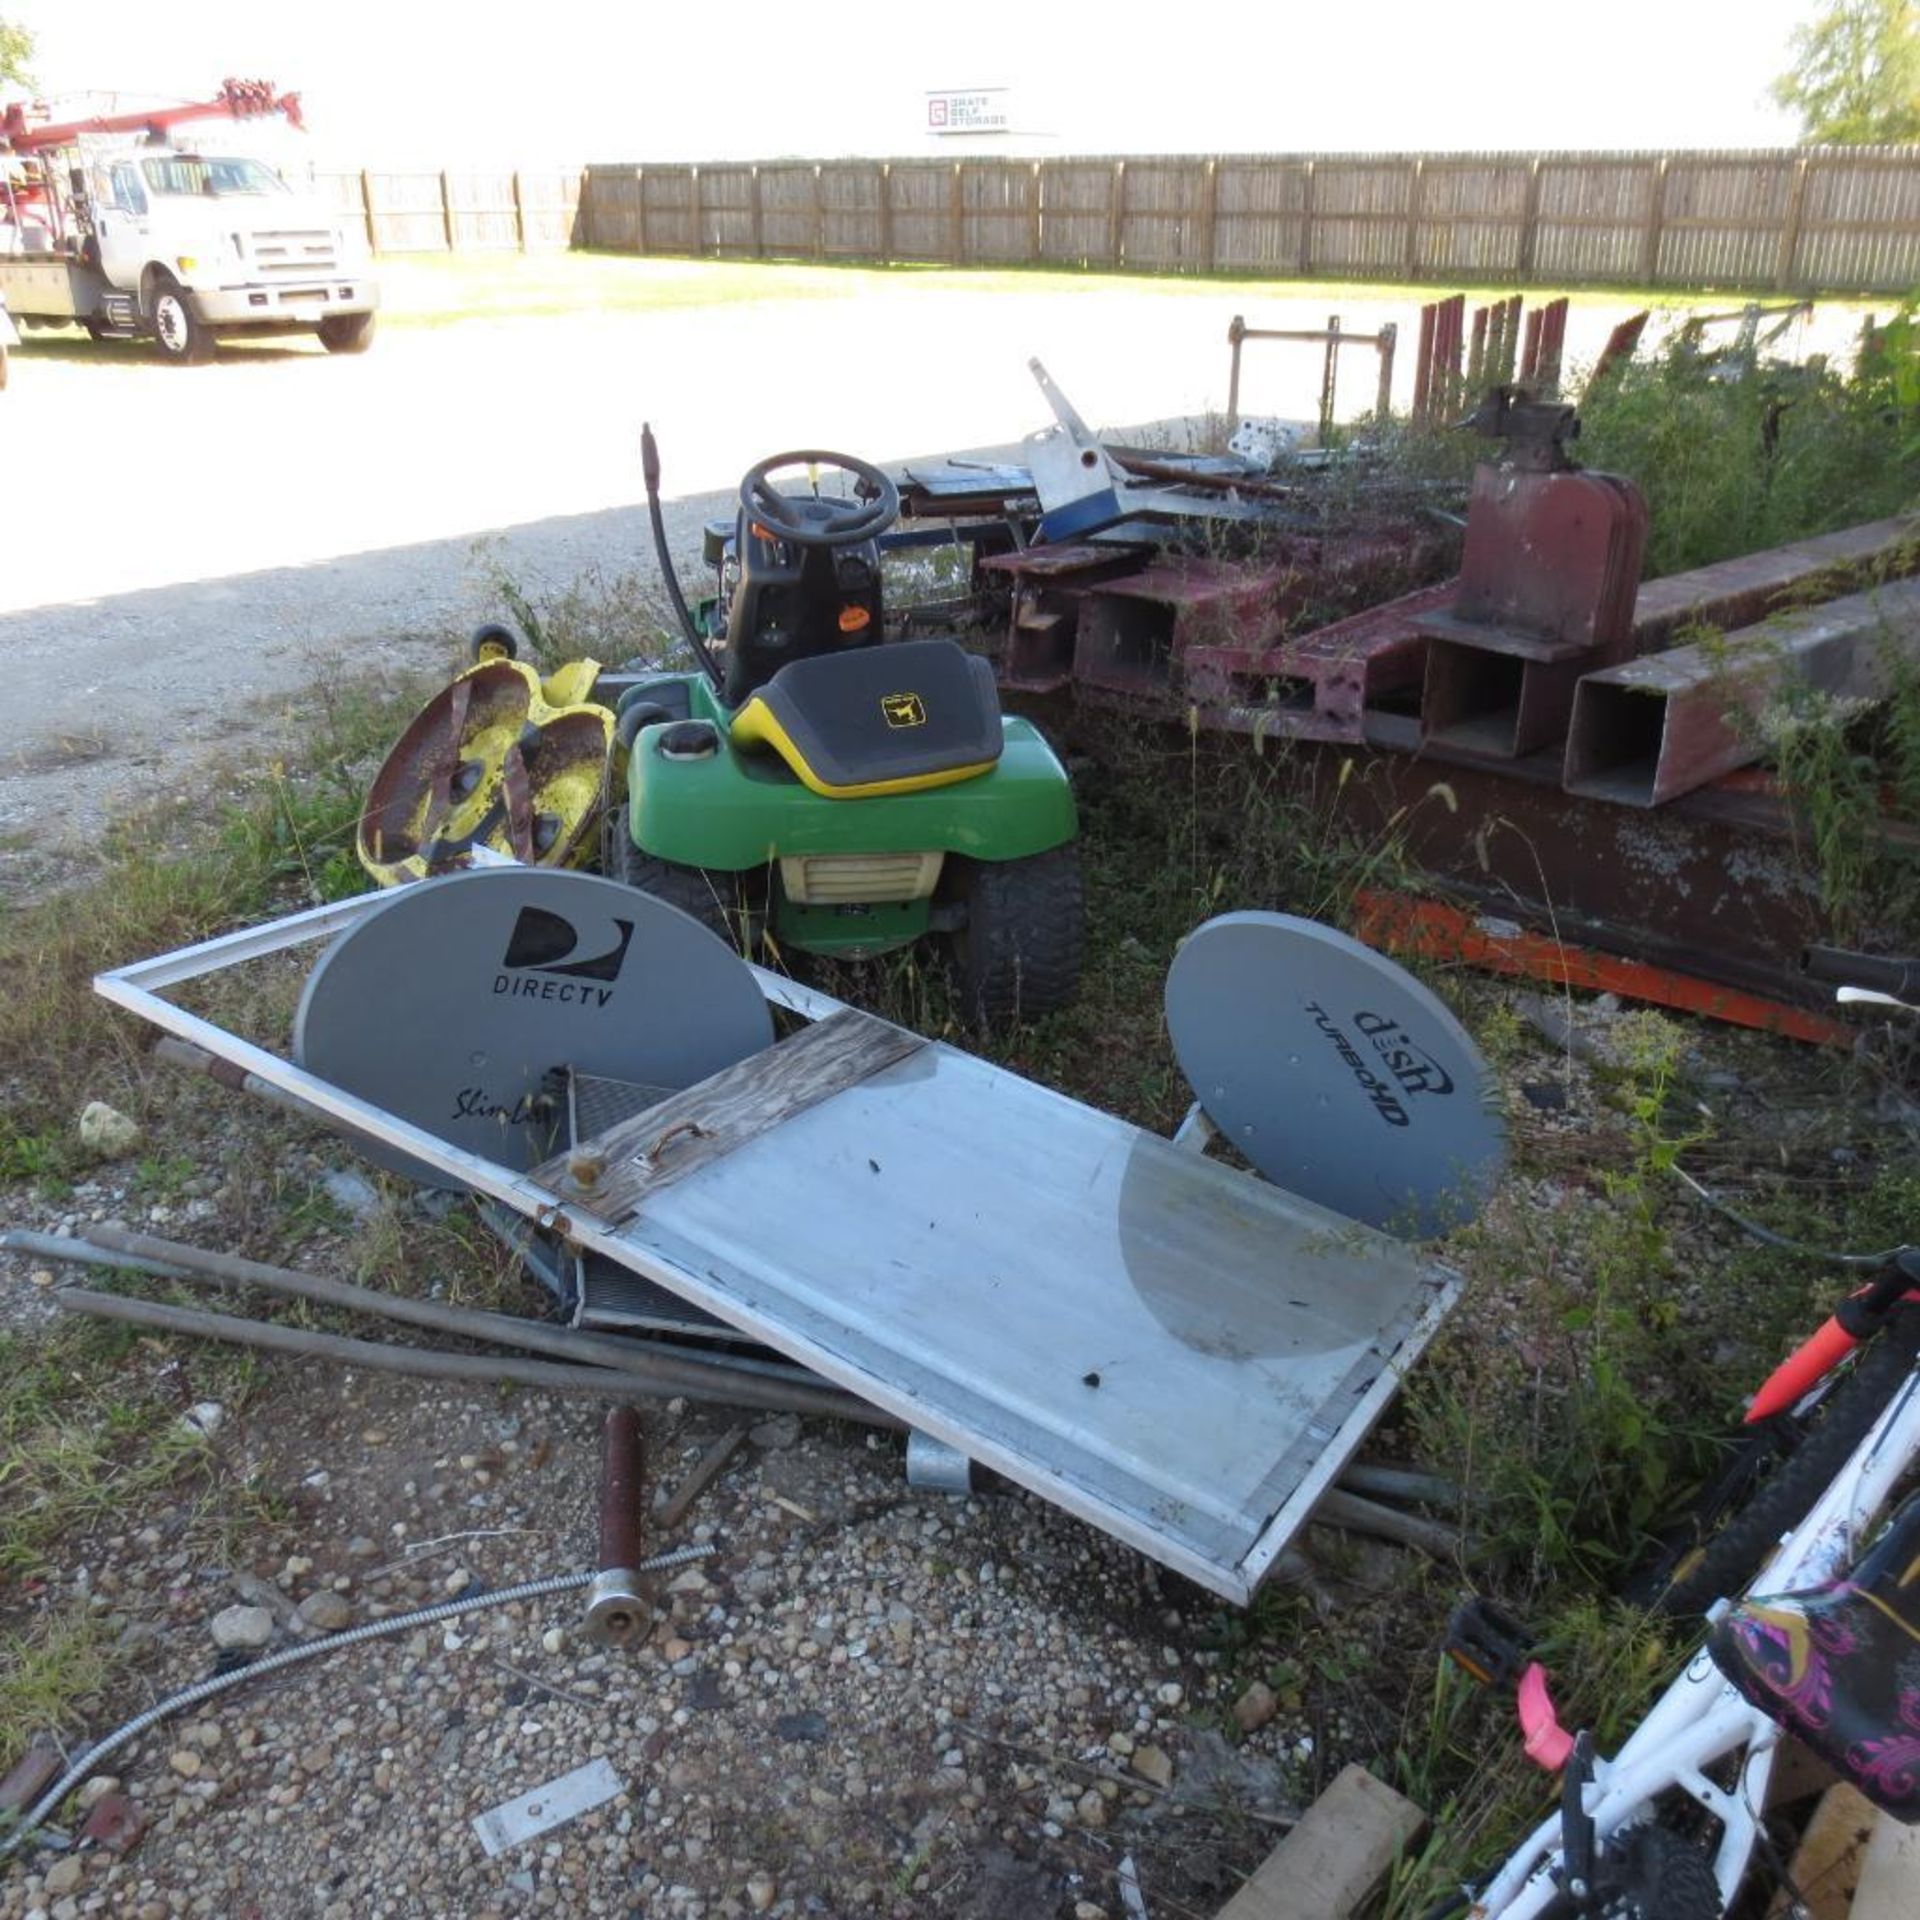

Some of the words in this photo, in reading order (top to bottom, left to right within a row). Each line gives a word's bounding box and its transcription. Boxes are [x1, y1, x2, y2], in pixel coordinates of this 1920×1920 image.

[950, 115, 1007, 126] STORAGE
[494, 975, 614, 1008] DIRECTV
[1304, 1001, 1410, 1127] TURBOHD
[1353, 1012, 1433, 1096] dish
